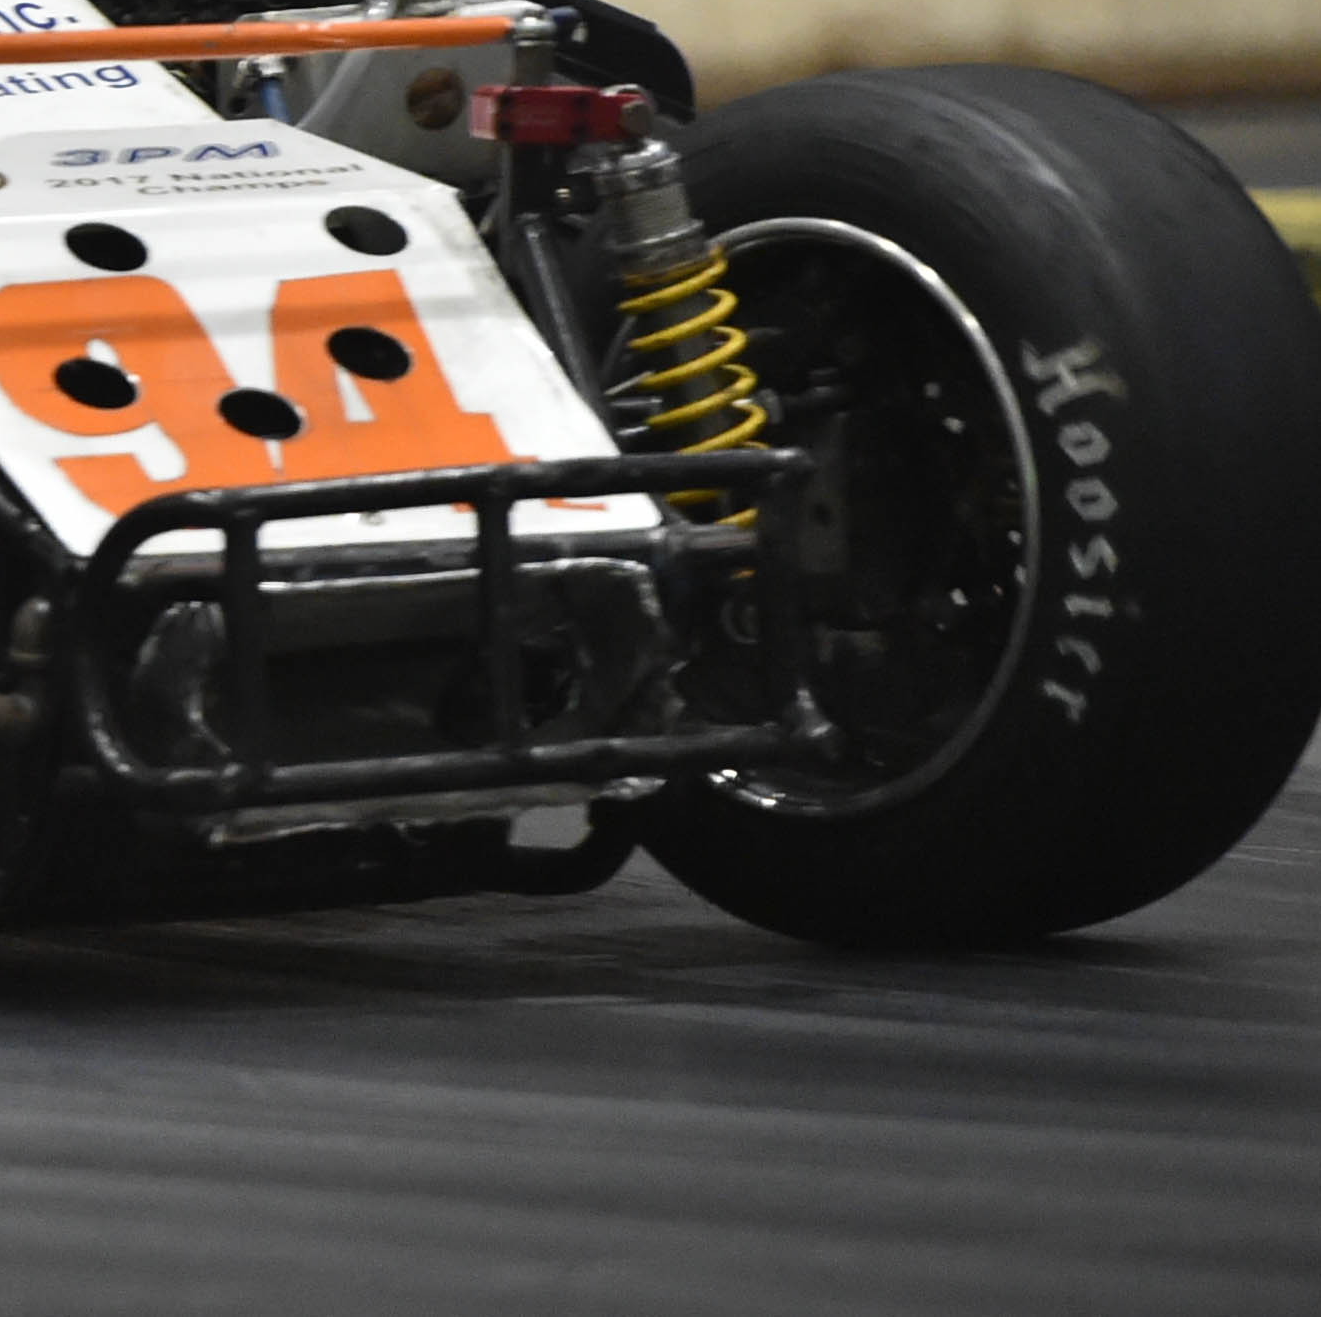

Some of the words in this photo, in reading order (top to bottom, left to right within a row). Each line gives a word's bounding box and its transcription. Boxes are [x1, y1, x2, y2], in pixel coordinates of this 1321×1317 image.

[50, 140, 282, 167] 3PM
[46, 175, 150, 189] 2017
[167, 163, 365, 182] National
[136, 179, 332, 196] Champs
